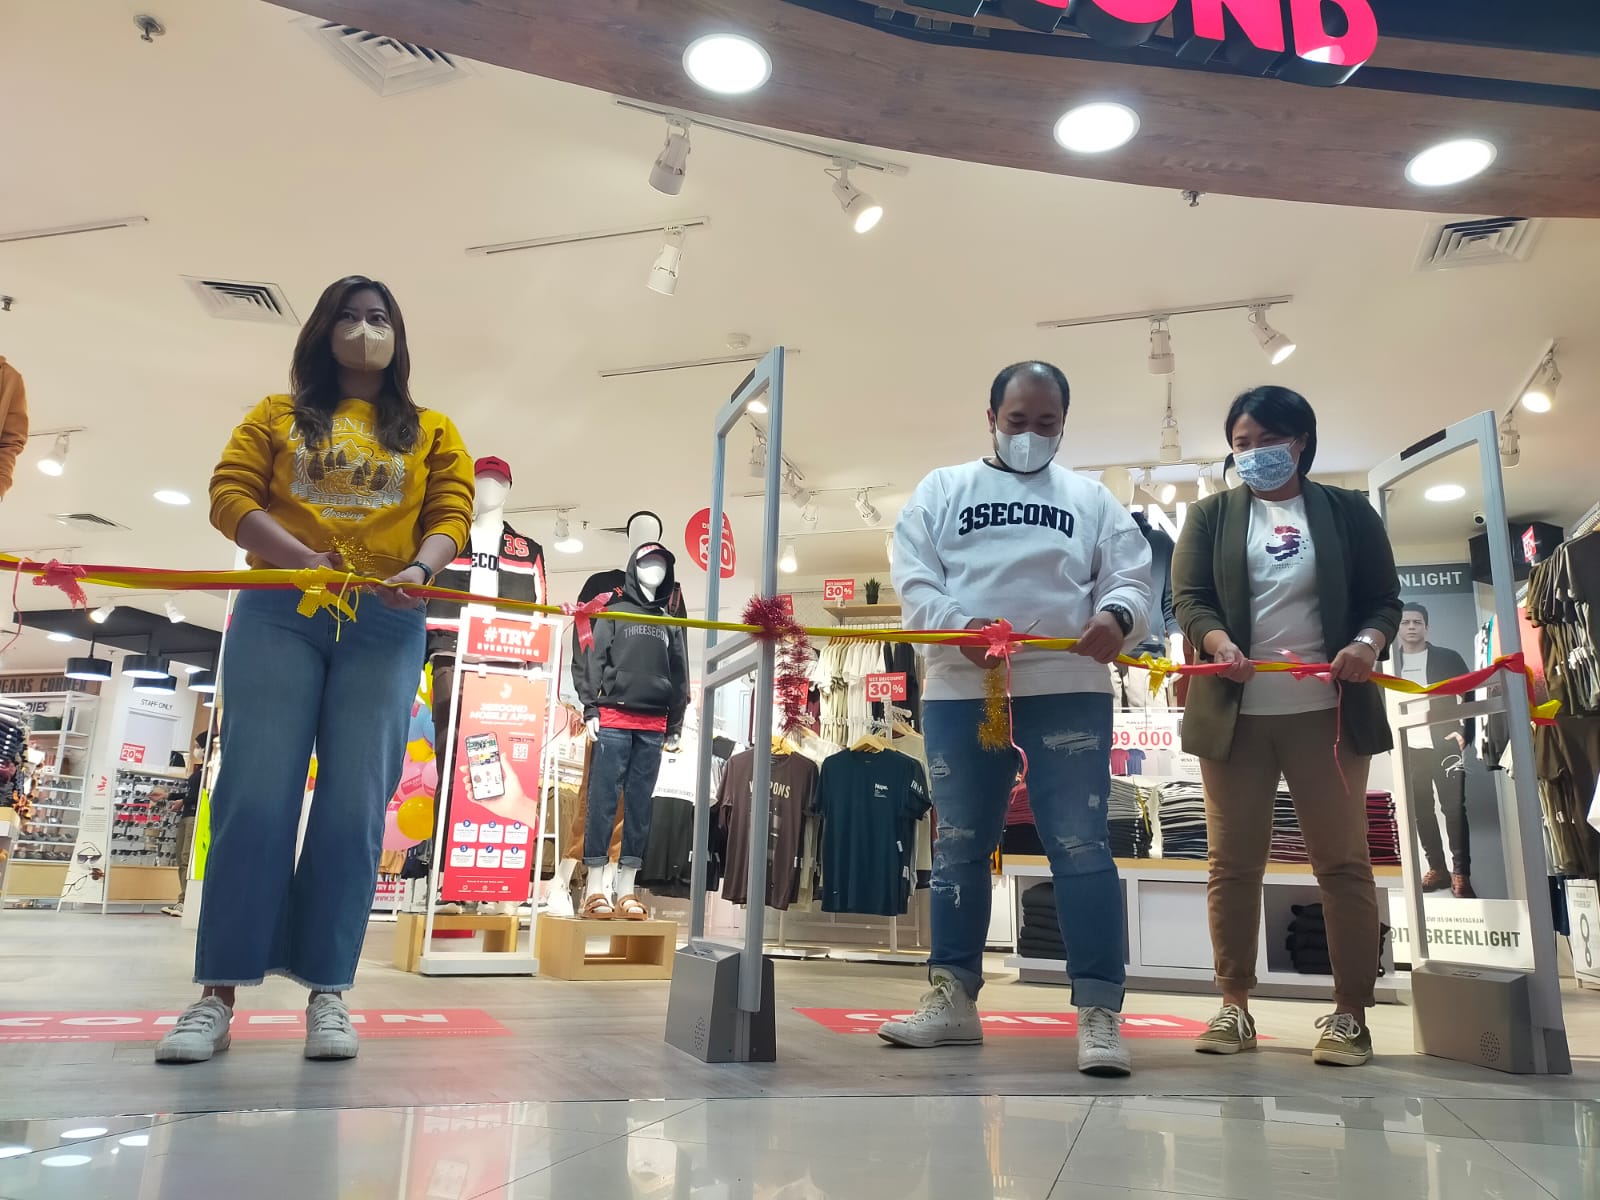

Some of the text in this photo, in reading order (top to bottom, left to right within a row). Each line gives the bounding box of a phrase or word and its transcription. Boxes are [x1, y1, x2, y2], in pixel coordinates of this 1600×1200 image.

[958, 502, 1075, 539] 3SECOND
[504, 534, 530, 557] 3S
[484, 626, 536, 647] #TRY
[477, 643, 539, 657] EVERYTHING
[0, 678, 32, 693] EANS
[870, 683, 904, 698] 30%
[141, 698, 173, 710] STAFF ONLY
